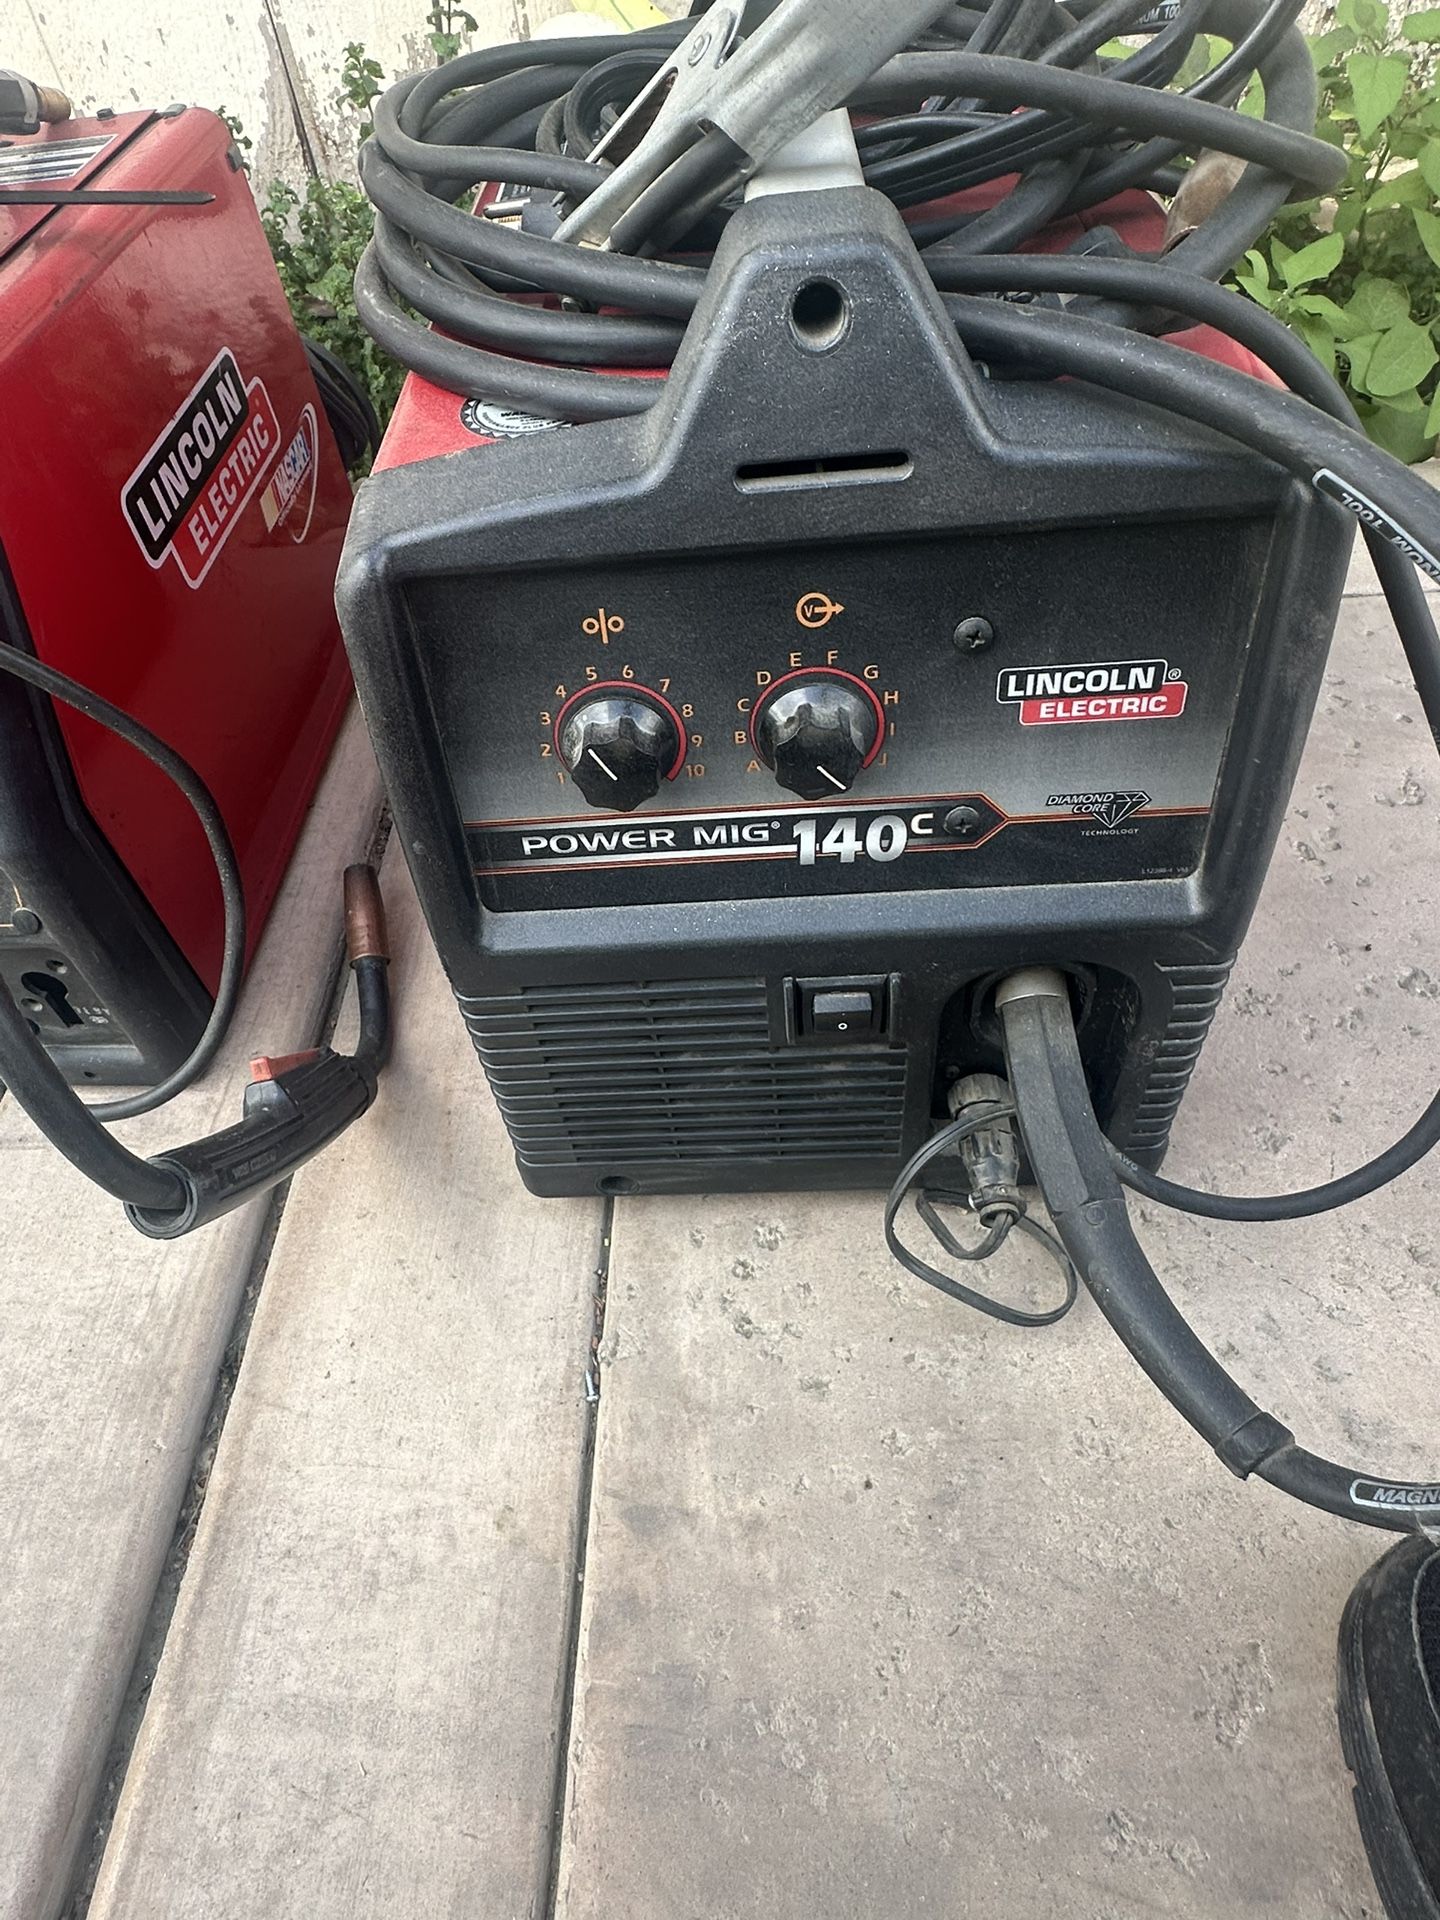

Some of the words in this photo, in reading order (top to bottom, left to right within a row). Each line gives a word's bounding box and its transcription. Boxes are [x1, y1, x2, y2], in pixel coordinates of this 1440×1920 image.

[136, 371, 242, 541] LINCOLN
[188, 413, 270, 555] ELECTRIC
[1342, 492, 1383, 528] 100L
[790, 653, 802, 667] E
[827, 650, 838, 665] F
[585, 666, 597, 680] 5
[622, 665, 634, 678] 6
[756, 671, 771, 685] D
[864, 665, 879, 679] G
[659, 678, 670, 692] 7
[1007, 666, 1156, 697] LINCOLN
[555, 685, 567, 698] 4
[884, 691, 899, 705] H
[682, 704, 694, 718] 8
[737, 699, 750, 712] C
[1039, 696, 1167, 718] ELECTRIC
[540, 712, 551, 725] 3
[889, 722, 895, 736] I
[691, 735, 702, 747] 9
[734, 731, 747, 744] B
[540, 744, 552, 757] 2
[747, 760, 760, 772] A
[878, 753, 887, 766] J
[686, 764, 705, 777] 10
[557, 772, 565, 784] 1
[1047, 793, 1114, 805] DIAMOND
[1073, 803, 1110, 813] CORE
[1081, 828, 1139, 836] TECHNOLOGY
[521, 828, 677, 855] POWER
[1373, 1488, 1440, 1504] MAGN
